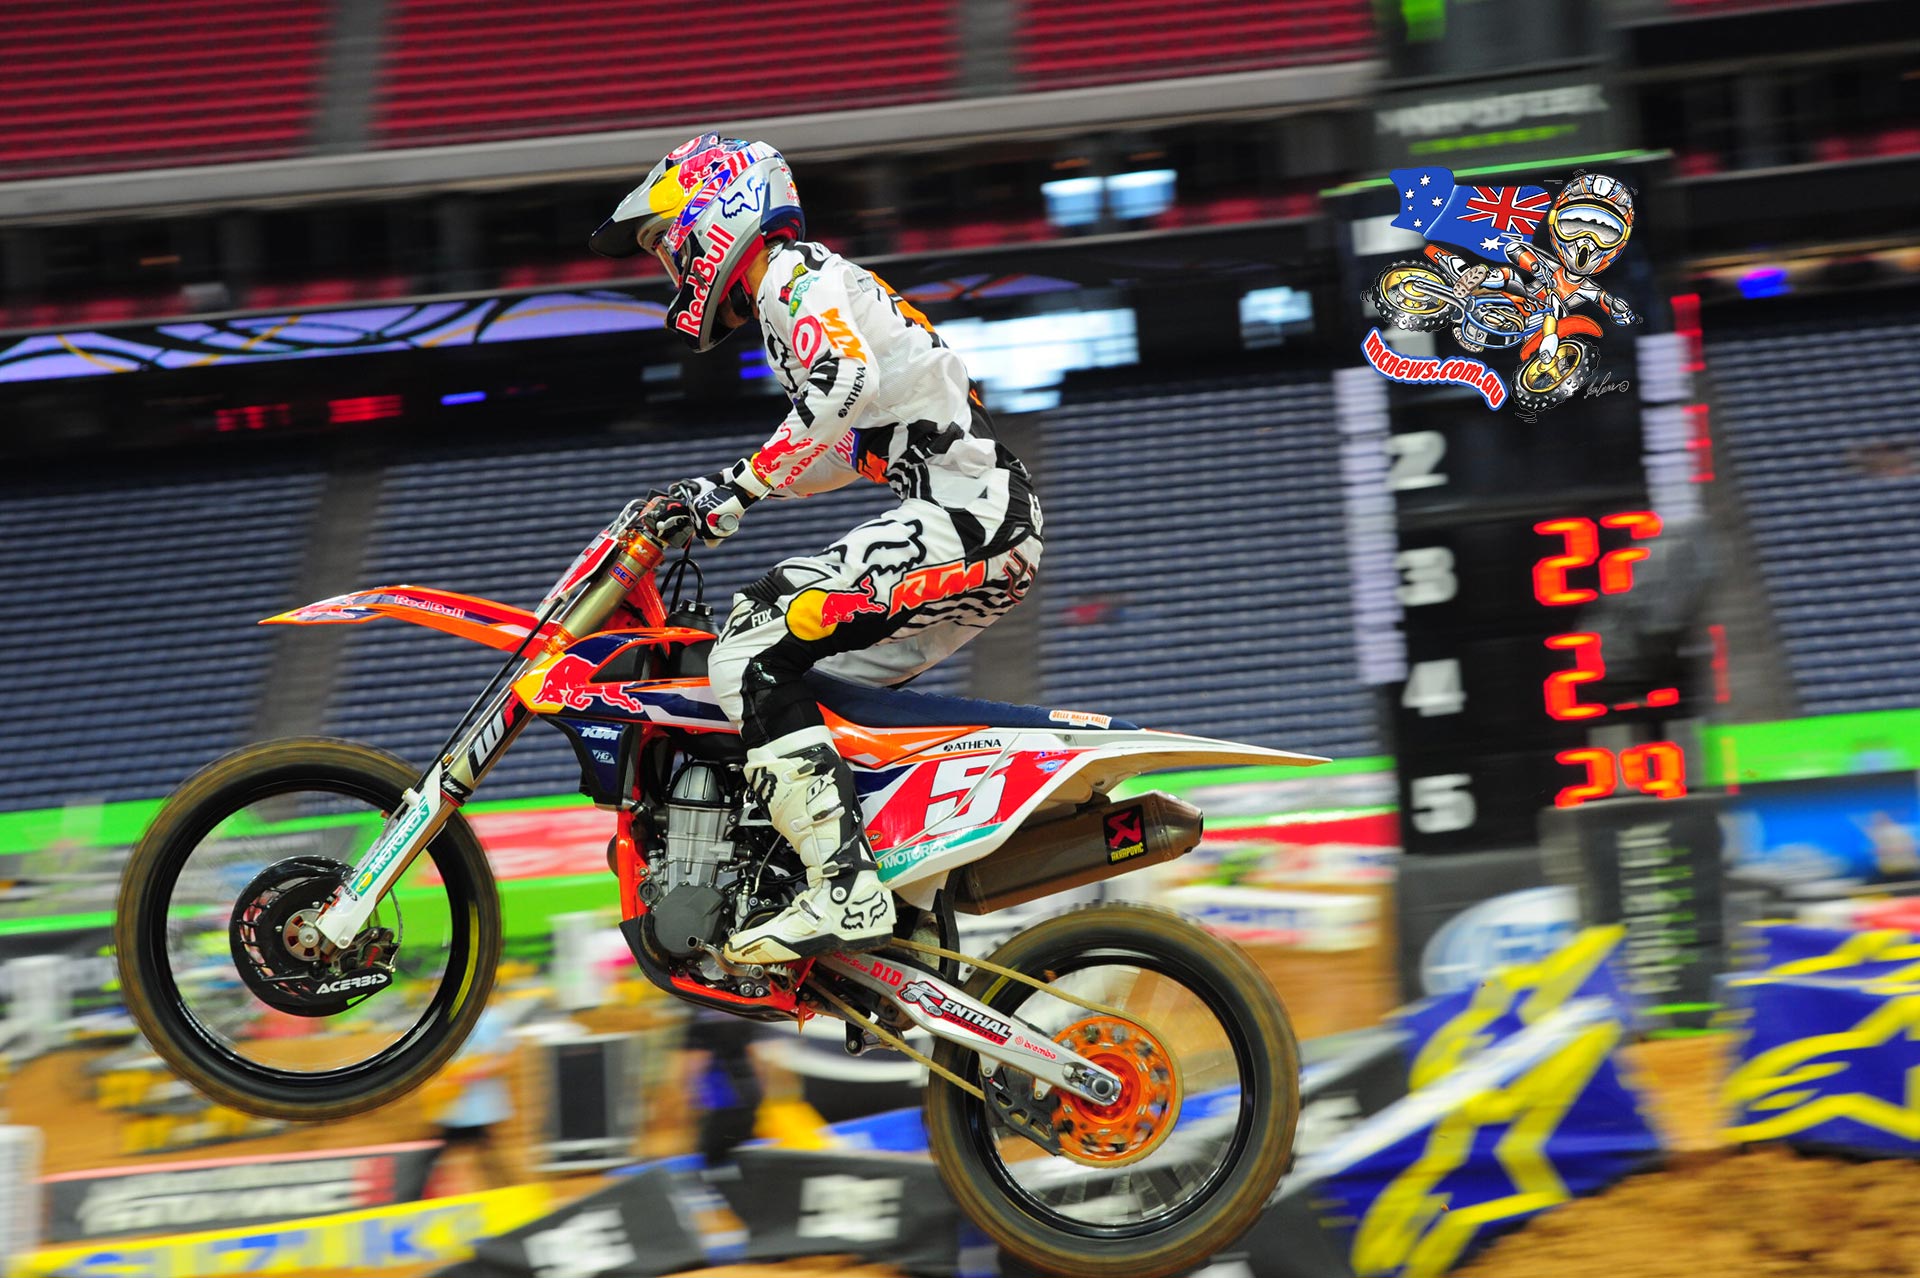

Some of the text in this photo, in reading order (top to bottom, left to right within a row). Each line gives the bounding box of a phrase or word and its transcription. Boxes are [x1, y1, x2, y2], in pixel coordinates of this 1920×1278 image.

[675, 223, 736, 338] Red Bull
[819, 307, 867, 364] KTM
[843, 366, 866, 411] ATHENA
[1386, 431, 1449, 490] 2
[887, 561, 987, 619] KTM
[1396, 546, 1458, 606] 3
[394, 594, 466, 619] Red Bull
[751, 608, 774, 628] FOX
[1402, 659, 1467, 717] 4
[953, 738, 1002, 751] ATHENA
[924, 754, 1017, 837] 5
[1411, 773, 1476, 834] 5
[368, 806, 429, 876] MOTOREX
[1024, 1041, 1057, 1060] brembo
